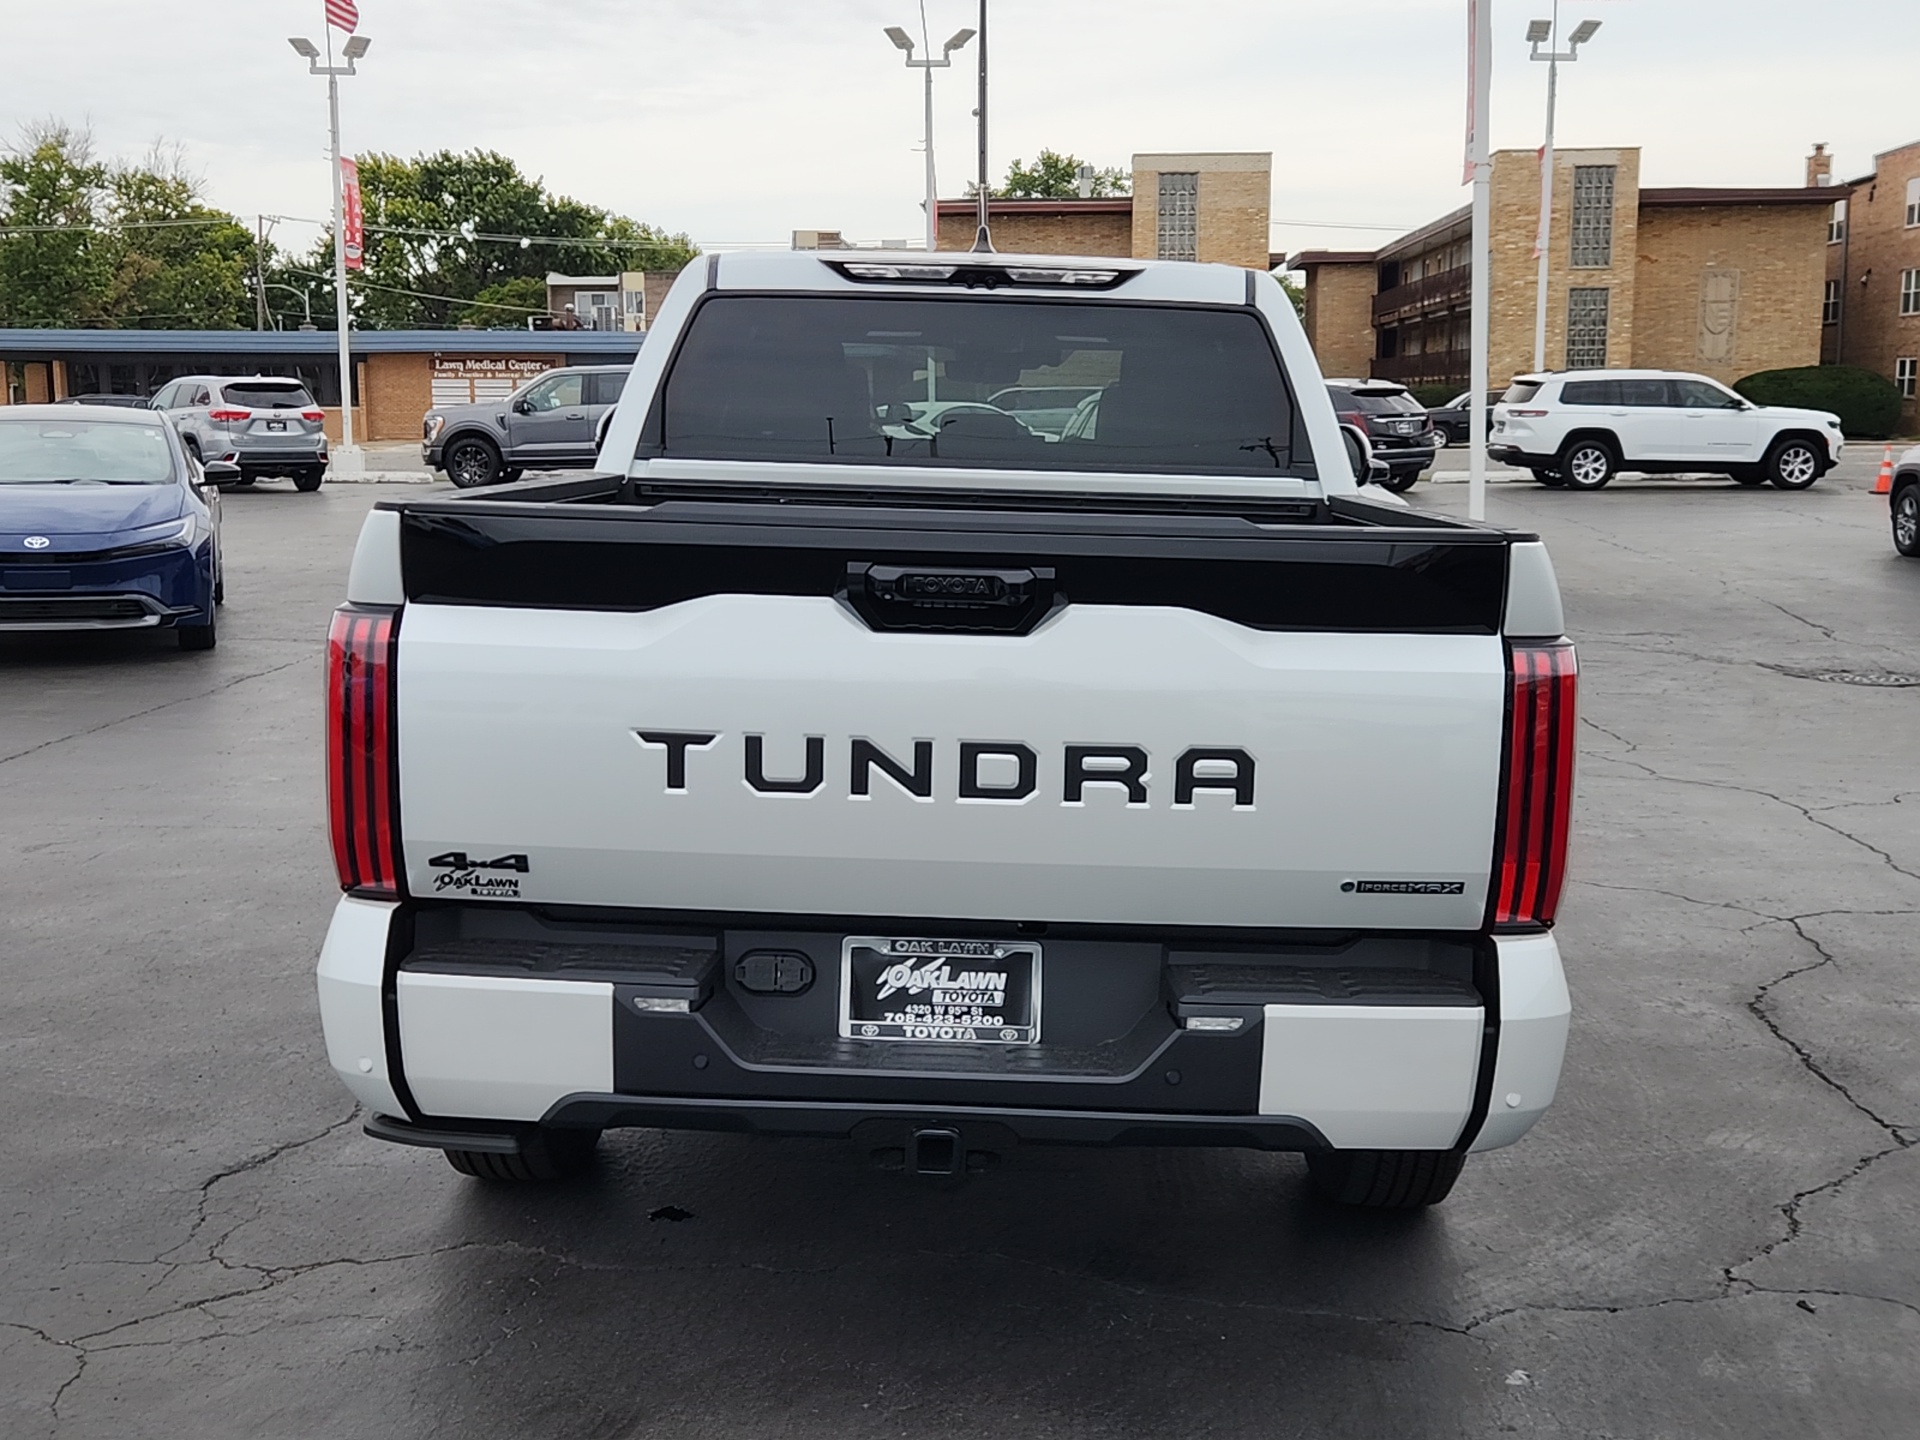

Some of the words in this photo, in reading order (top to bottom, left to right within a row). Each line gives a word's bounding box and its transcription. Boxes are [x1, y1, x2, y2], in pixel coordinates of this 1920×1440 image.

[435, 359, 464, 371] Lawn
[465, 359, 506, 370] Medical
[508, 359, 542, 371] Center
[913, 576, 990, 594] TOYOTA
[631, 729, 1258, 810] TUNDRA
[474, 888, 518, 897] TOYOTA
[895, 940, 934, 953] OAK
[937, 941, 990, 954] LAWN
[940, 991, 997, 1004] TOYOTA
[905, 1004, 931, 1015] 4320
[933, 1005, 945, 1015] W
[970, 1006, 983, 1016] St
[884, 1012, 1004, 1026] 708-423-5200
[902, 1025, 977, 1040] TOYOTA
